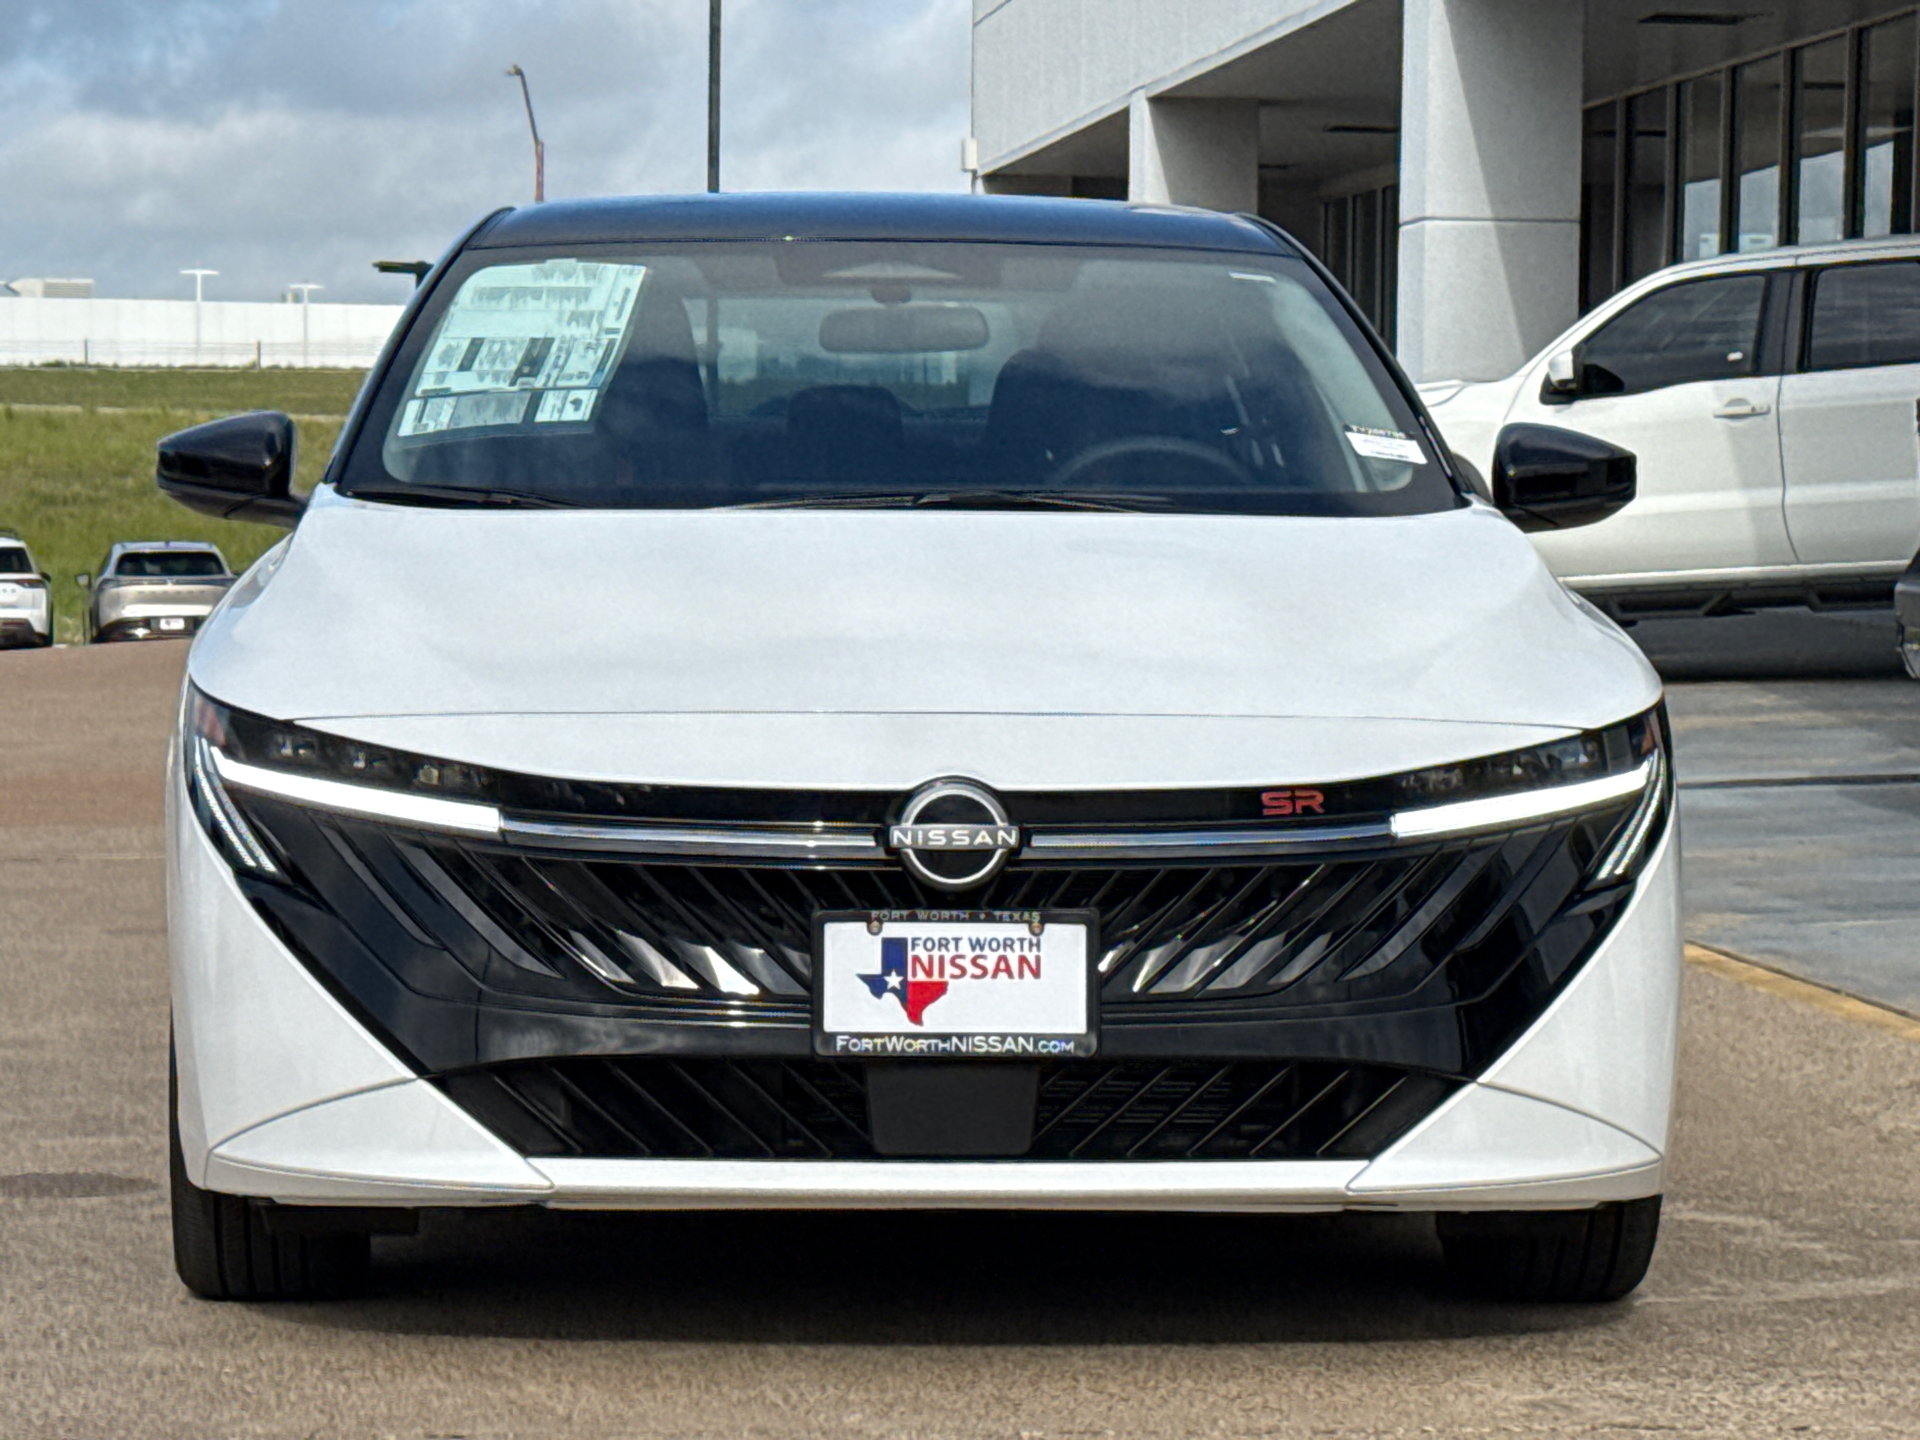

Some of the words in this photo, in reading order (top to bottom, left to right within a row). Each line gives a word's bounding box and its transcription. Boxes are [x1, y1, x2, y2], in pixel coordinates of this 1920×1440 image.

[1260, 790, 1325, 815] SR
[892, 829, 1018, 846] NISSAN
[871, 910, 908, 921] FORT
[917, 910, 970, 921] WORTH
[993, 911, 1041, 922] TEXAS
[910, 936, 961, 952] FORT
[968, 936, 1042, 952] WORTH
[910, 953, 1042, 980] NISSAN
